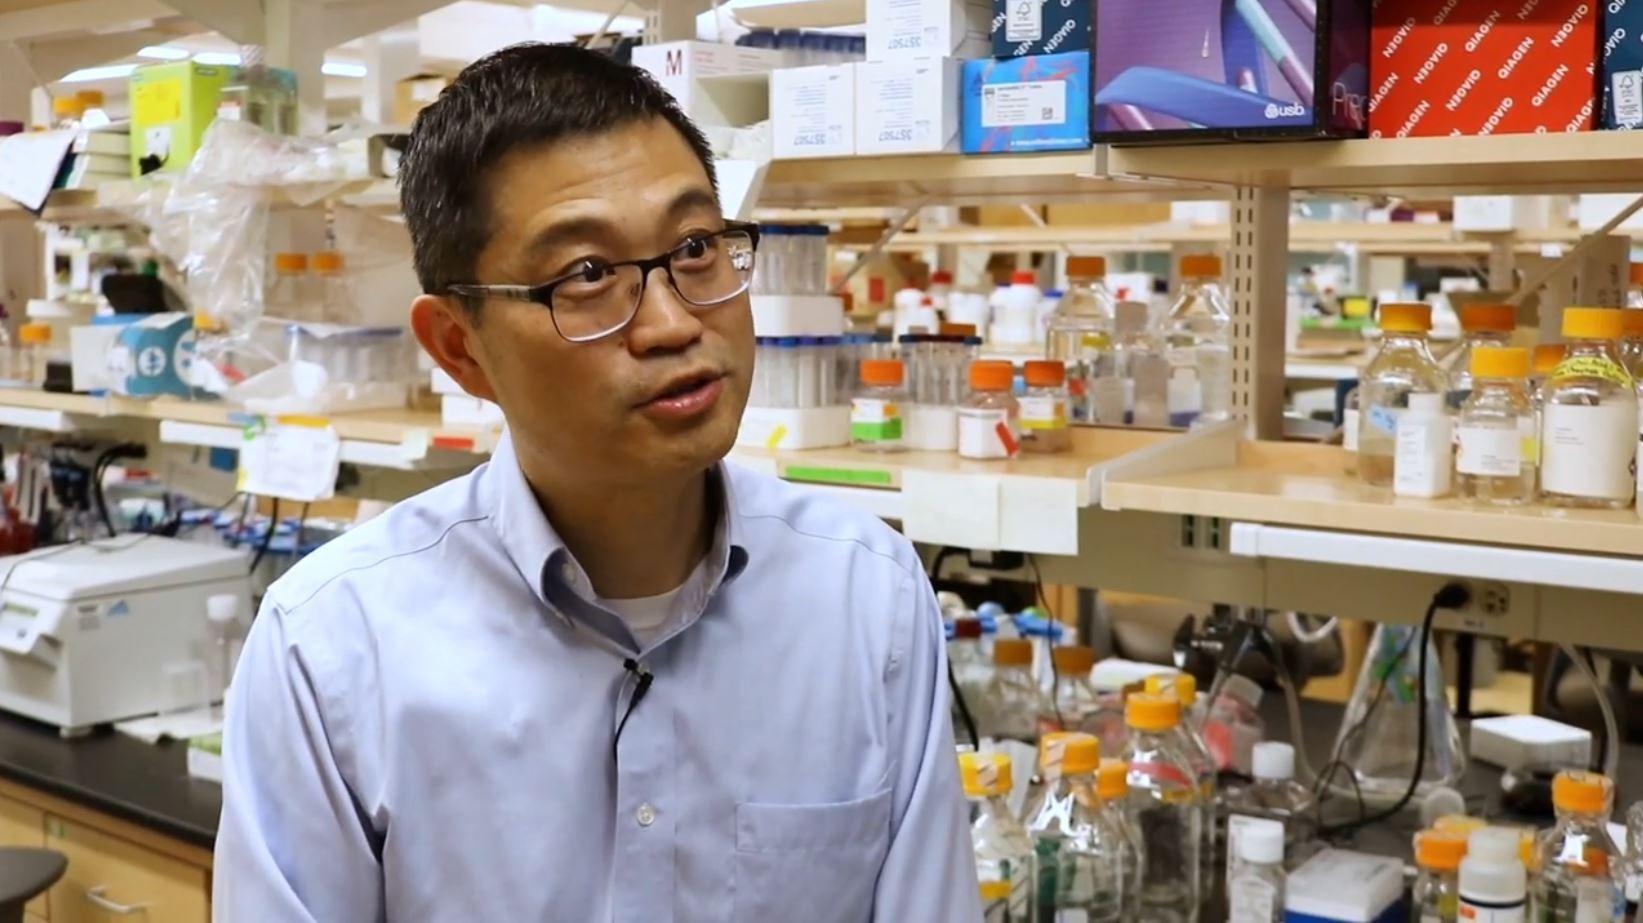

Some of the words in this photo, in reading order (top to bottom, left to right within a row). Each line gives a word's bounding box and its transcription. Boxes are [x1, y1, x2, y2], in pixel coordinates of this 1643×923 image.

[1433, 0, 1459, 25] QIAG
[1464, 10, 1500, 52] QIAGEN
[1550, 4, 1589, 48] QIAGEN
[1043, 19, 1076, 54] QIAGEN
[1382, 17, 1416, 58] QIAGEN
[665, 49, 682, 76] M
[1413, 42, 1449, 84] QIAGEN
[1497, 36, 1535, 79] QIAGEN
[1445, 69, 1482, 111] QIAGEN
[1530, 64, 1569, 107] QIAGEN
[1279, 102, 1305, 116] usb
[1396, 99, 1431, 139] QIAGEN
